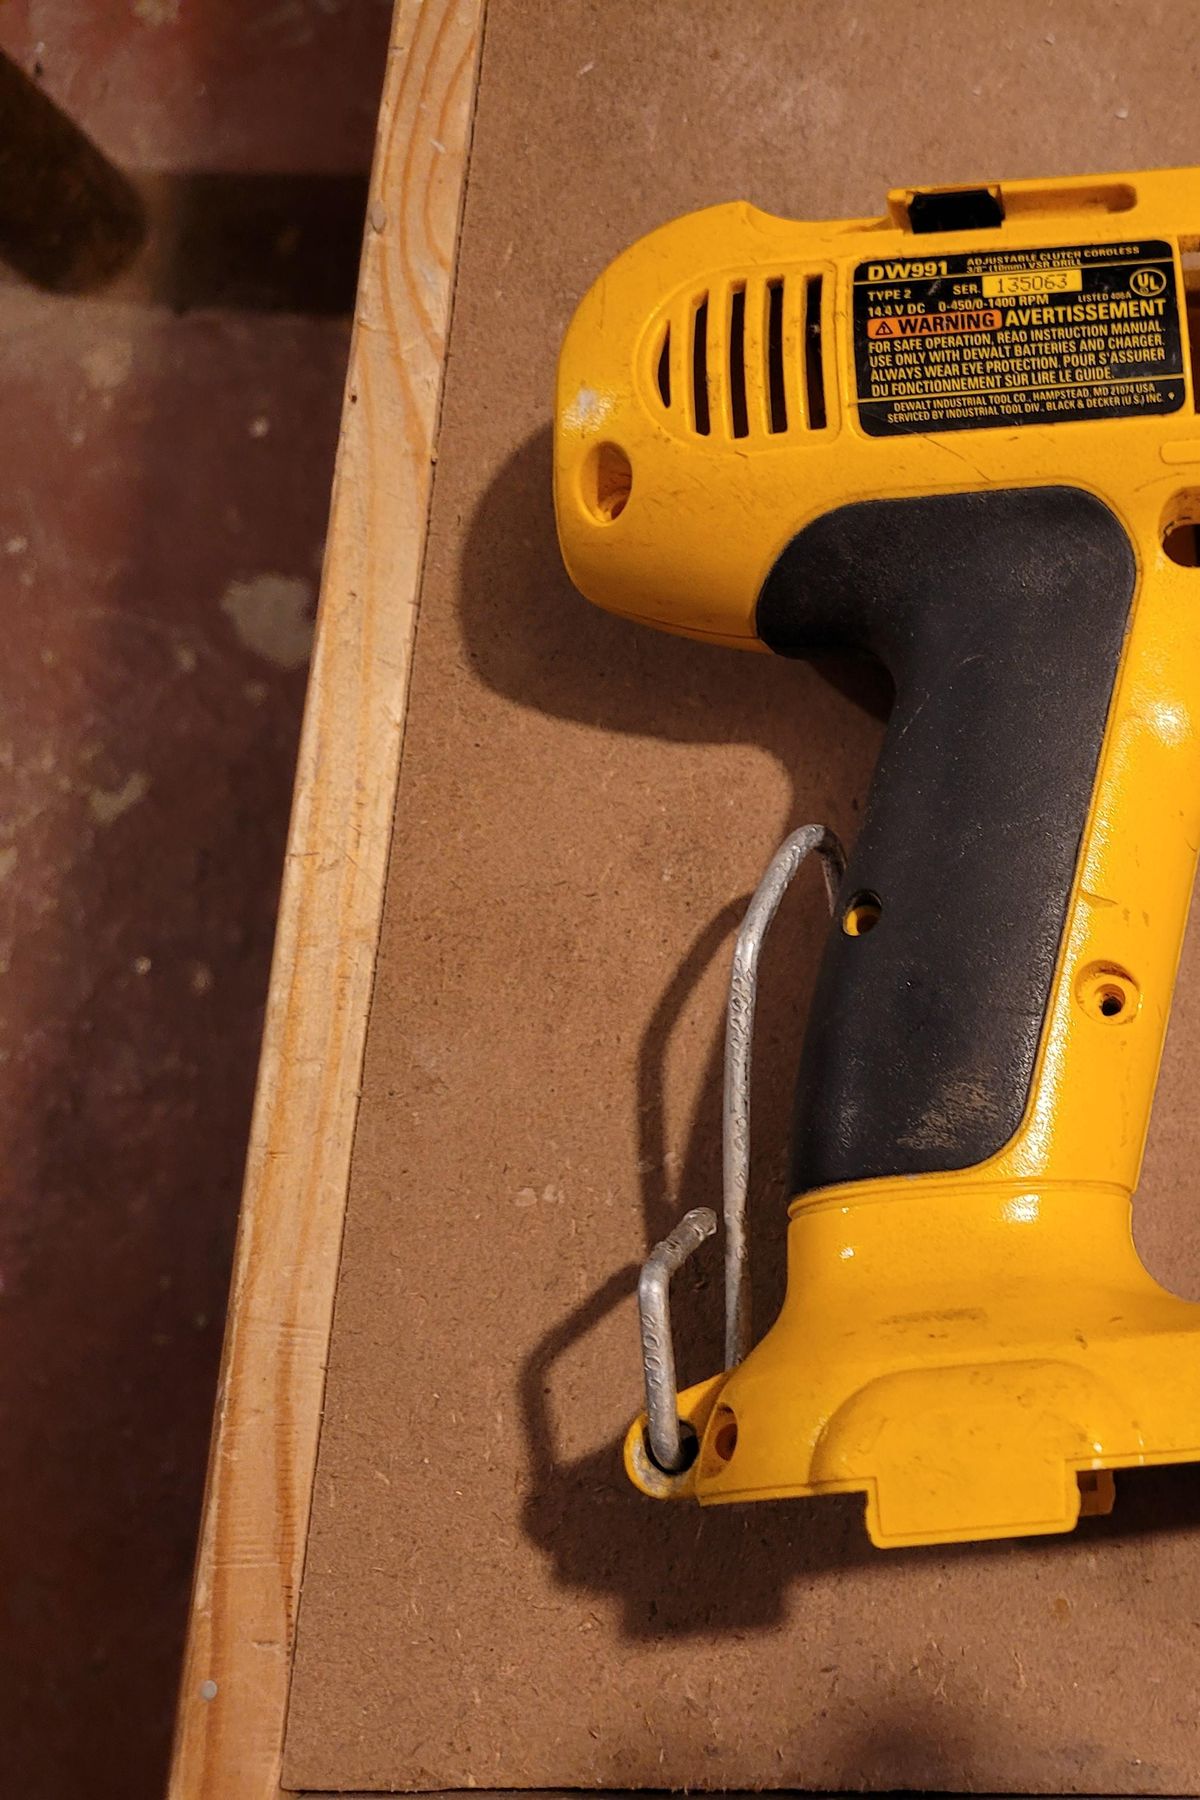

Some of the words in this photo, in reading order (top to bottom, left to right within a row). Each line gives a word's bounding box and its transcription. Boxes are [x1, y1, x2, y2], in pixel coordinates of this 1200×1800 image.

[966, 253, 1037, 266] ADJUSTABLE
[1040, 250, 1082, 261] CLUTCH
[1084, 246, 1140, 258] CORDLESS
[1029, 260, 1050, 270] VSR
[1052, 259, 1082, 268] DRILL
[867, 260, 948, 282] DW991
[868, 290, 901, 302] TYPE
[904, 288, 912, 299] 2
[952, 284, 981, 295] SER.
[998, 273, 1068, 294] 135063
[868, 305, 893, 318] 14.4
[894, 304, 904, 316] V
[907, 303, 926, 314] DC
[938, 297, 1016, 312] 0-450/0-1400
[1018, 294, 1049, 306] RPM
[1078, 292, 1109, 303] LISTED
[898, 312, 995, 335] WARNING
[1005, 300, 1167, 326] AVERTISSEMENT
[868, 340, 891, 354] FOR
[894, 338, 922, 352] SAFE
[997, 331, 1028, 344] READ
[1030, 326, 1108, 342] INSTRUCTION
[1110, 321, 1166, 336] MANUAL.
[869, 354, 892, 368] USE
[895, 352, 926, 366] ONLY
[928, 350, 960, 364] WITH
[963, 346, 1011, 361] DEWALT
[1014, 341, 1076, 357] BATTERIES
[1080, 339, 1105, 352] AND
[1108, 334, 1165, 350] CHARGER.
[870, 367, 922, 382] ALWAYS
[924, 363, 959, 378] WEAR
[962, 362, 984, 376] EYE
[986, 356, 1061, 374] PROTECTION.
[1063, 354, 1096, 368] POUR
[1098, 348, 1166, 366] S'ASSURER
[872, 384, 889, 397] DU
[892, 376, 1002, 396] FONCTIONNEMENT
[1032, 372, 1056, 386] LIRE
[1059, 370, 1072, 383] LE
[1075, 366, 1115, 382] GUIDE.
[893, 400, 931, 412] DEWALT
[933, 395, 988, 410] INDUSTRIAL
[988, 394, 1012, 405] TOOL
[1093, 386, 1109, 396] MD
[1110, 385, 1135, 396] 21074
[1136, 383, 1156, 393] USA
[888, 411, 930, 424] SERVICED
[932, 410, 944, 420] BY
[946, 406, 1000, 419] INDUSTRIAL
[1000, 404, 1024, 414] TOOL
[1046, 400, 1076, 412] BLACK
[1077, 399, 1084, 409] &
[1086, 396, 1120, 408] DECKER
